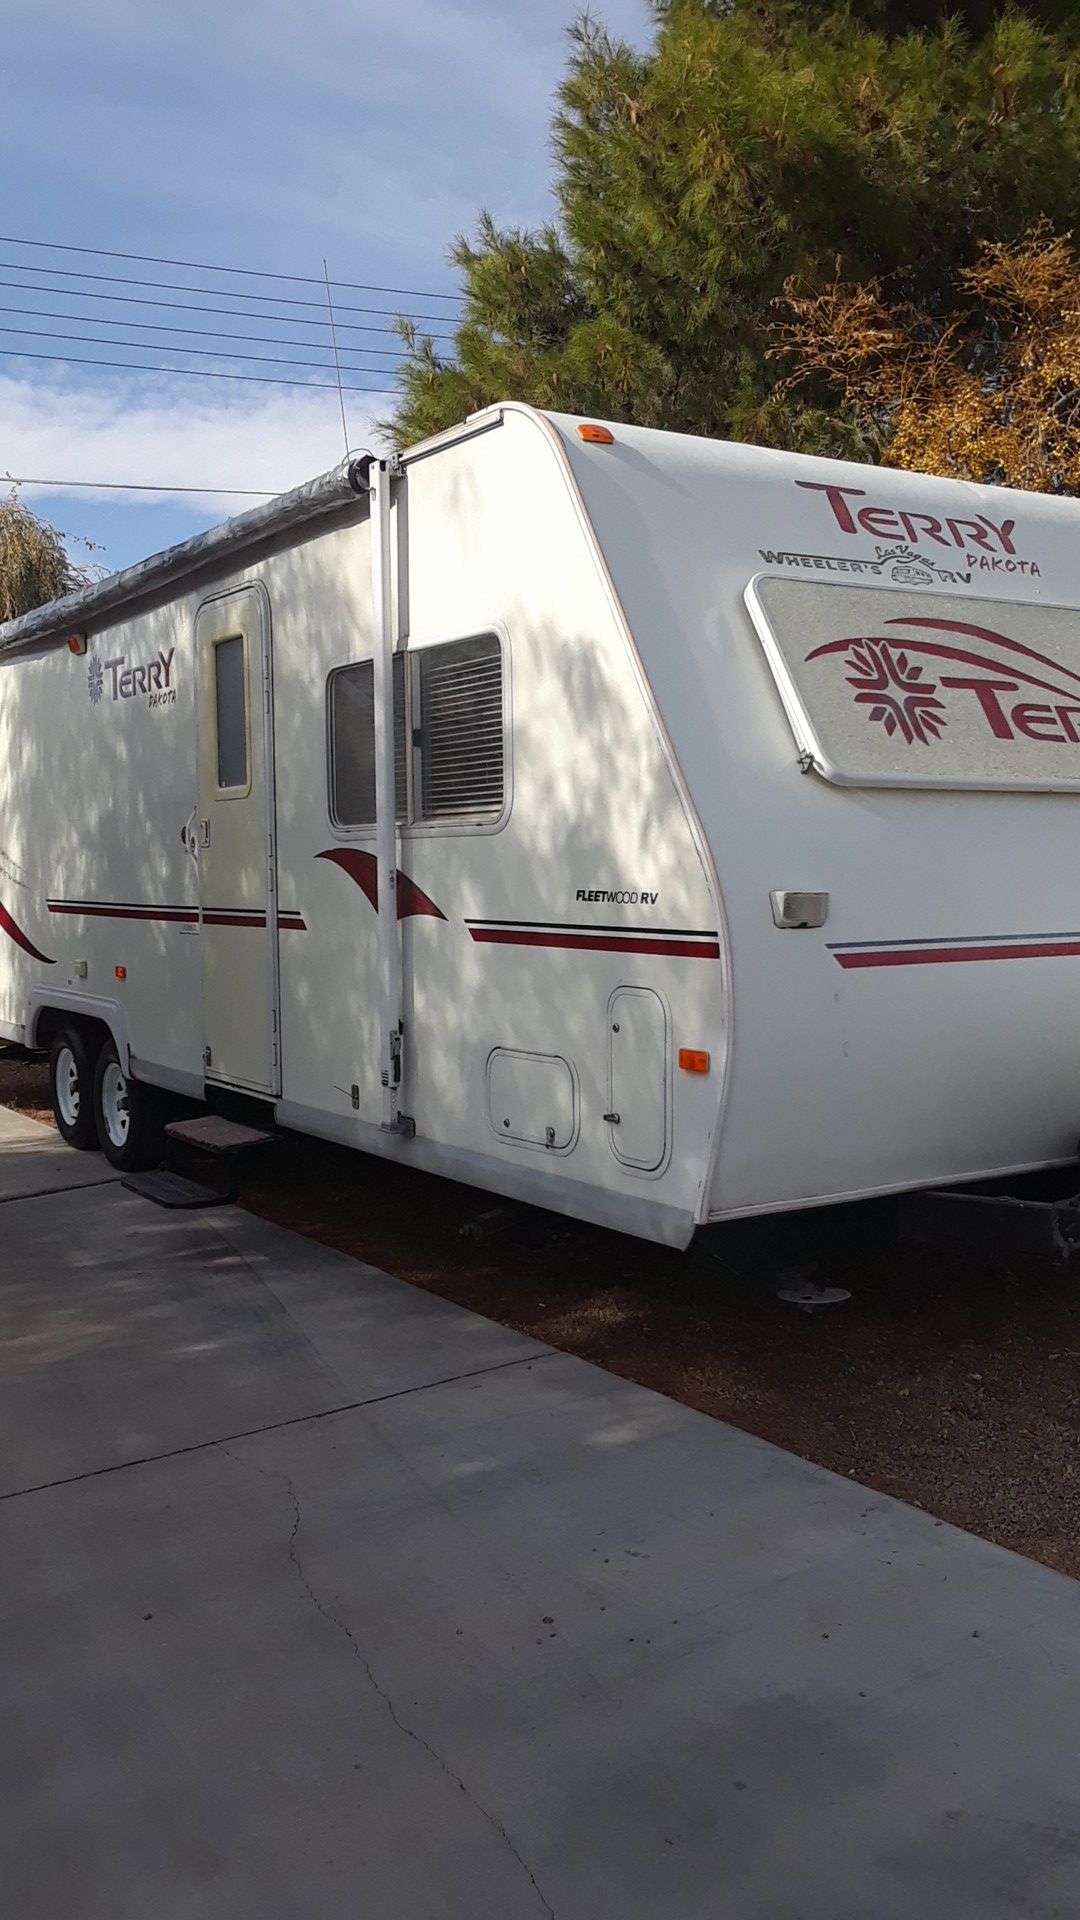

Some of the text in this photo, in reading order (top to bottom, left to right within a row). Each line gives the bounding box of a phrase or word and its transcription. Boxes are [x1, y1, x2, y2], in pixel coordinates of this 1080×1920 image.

[794, 480, 1016, 555] TERRY
[758, 549, 971, 584] WHEELER'S RV
[966, 552, 1041, 577] DAKOTA
[104, 647, 175, 701] TERRY
[148, 689, 177, 708] DAKOTA
[576, 889, 659, 904] FLEETWOOD RV
